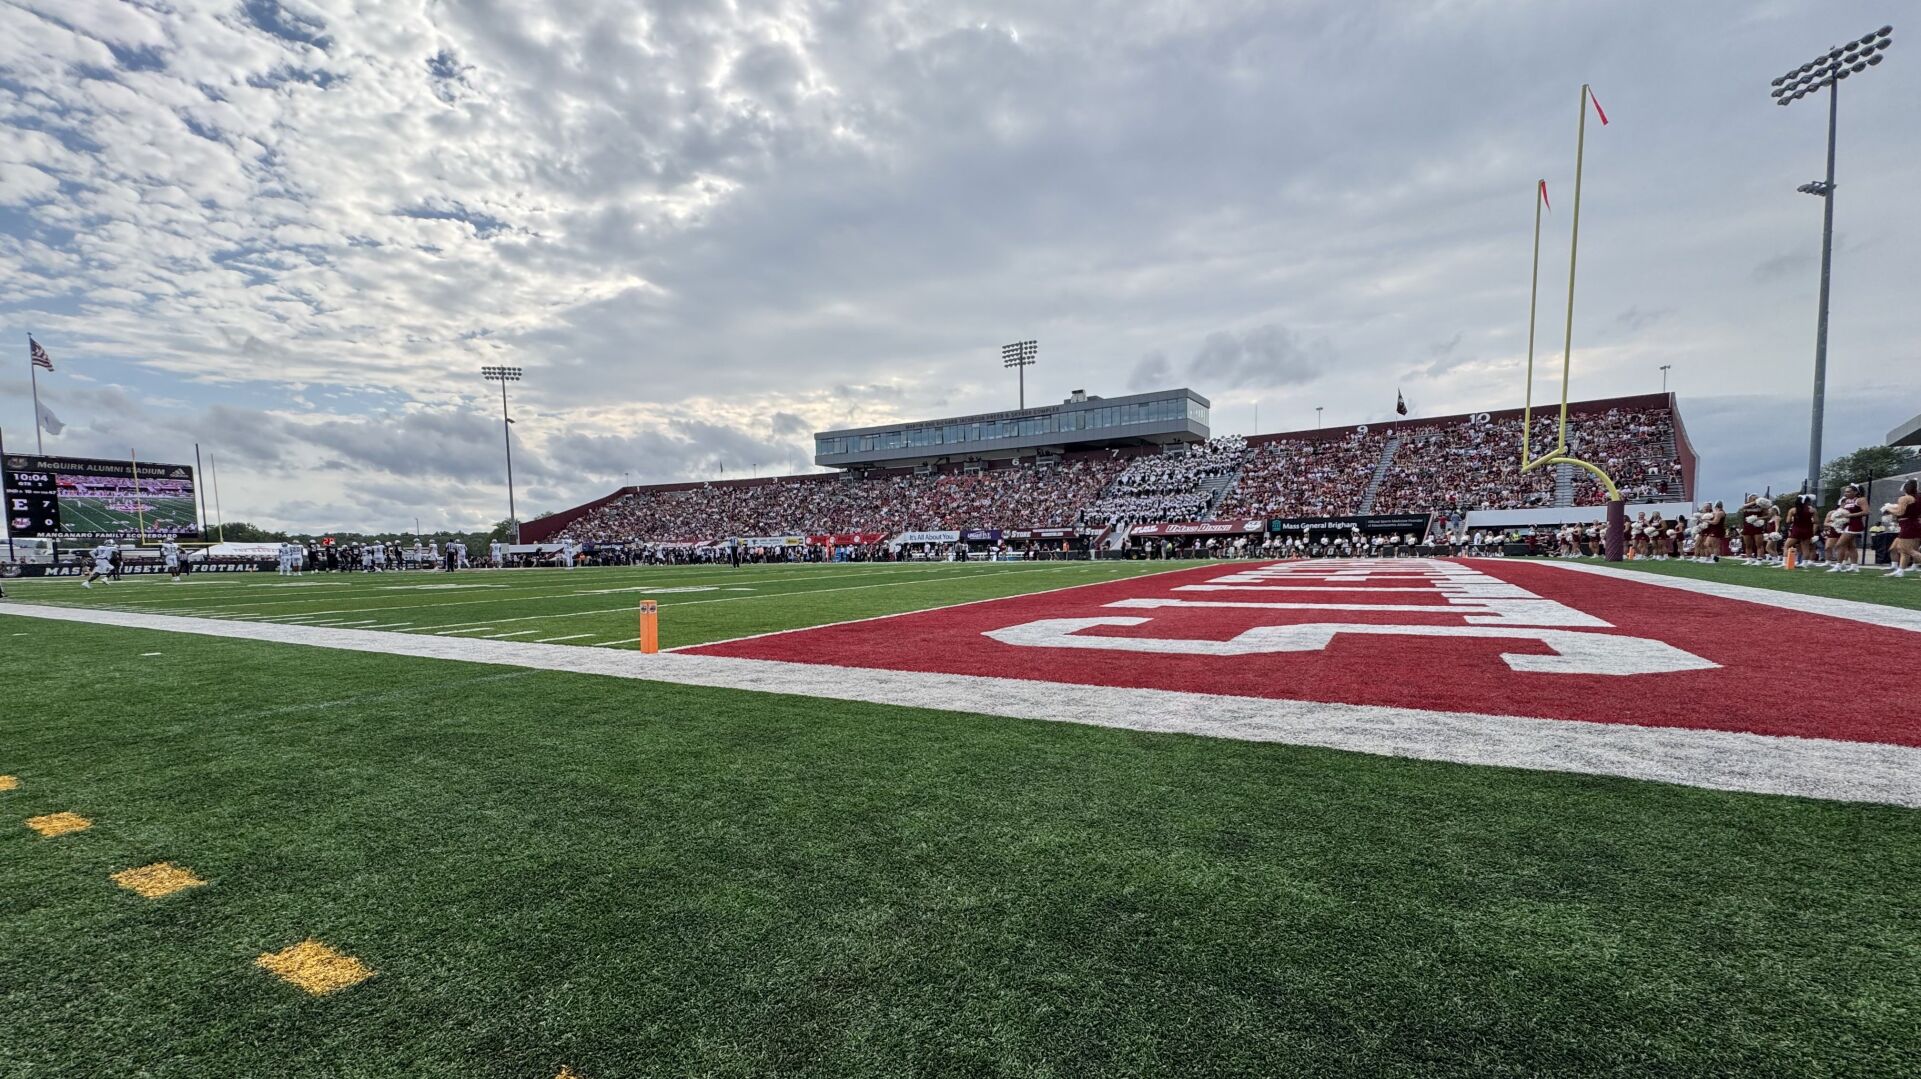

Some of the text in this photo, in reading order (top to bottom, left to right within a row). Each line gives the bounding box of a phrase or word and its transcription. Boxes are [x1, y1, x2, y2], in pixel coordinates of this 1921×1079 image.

[1469, 413, 1491, 424] 10
[1357, 425, 1369, 434] 9
[1111, 449, 1119, 457] 7
[1012, 458, 1019, 466] 6
[37, 461, 84, 471] McGUIRK
[86, 464, 123, 473] ALUMNI
[13, 473, 48, 481] 10:04
[11, 498, 50, 511] E 7
[44, 518, 54, 526] 0
[1328, 521, 1358, 530] Brigham
[1085, 528, 1104, 536] STOR
[192, 563, 260, 573] FOOTBALL
